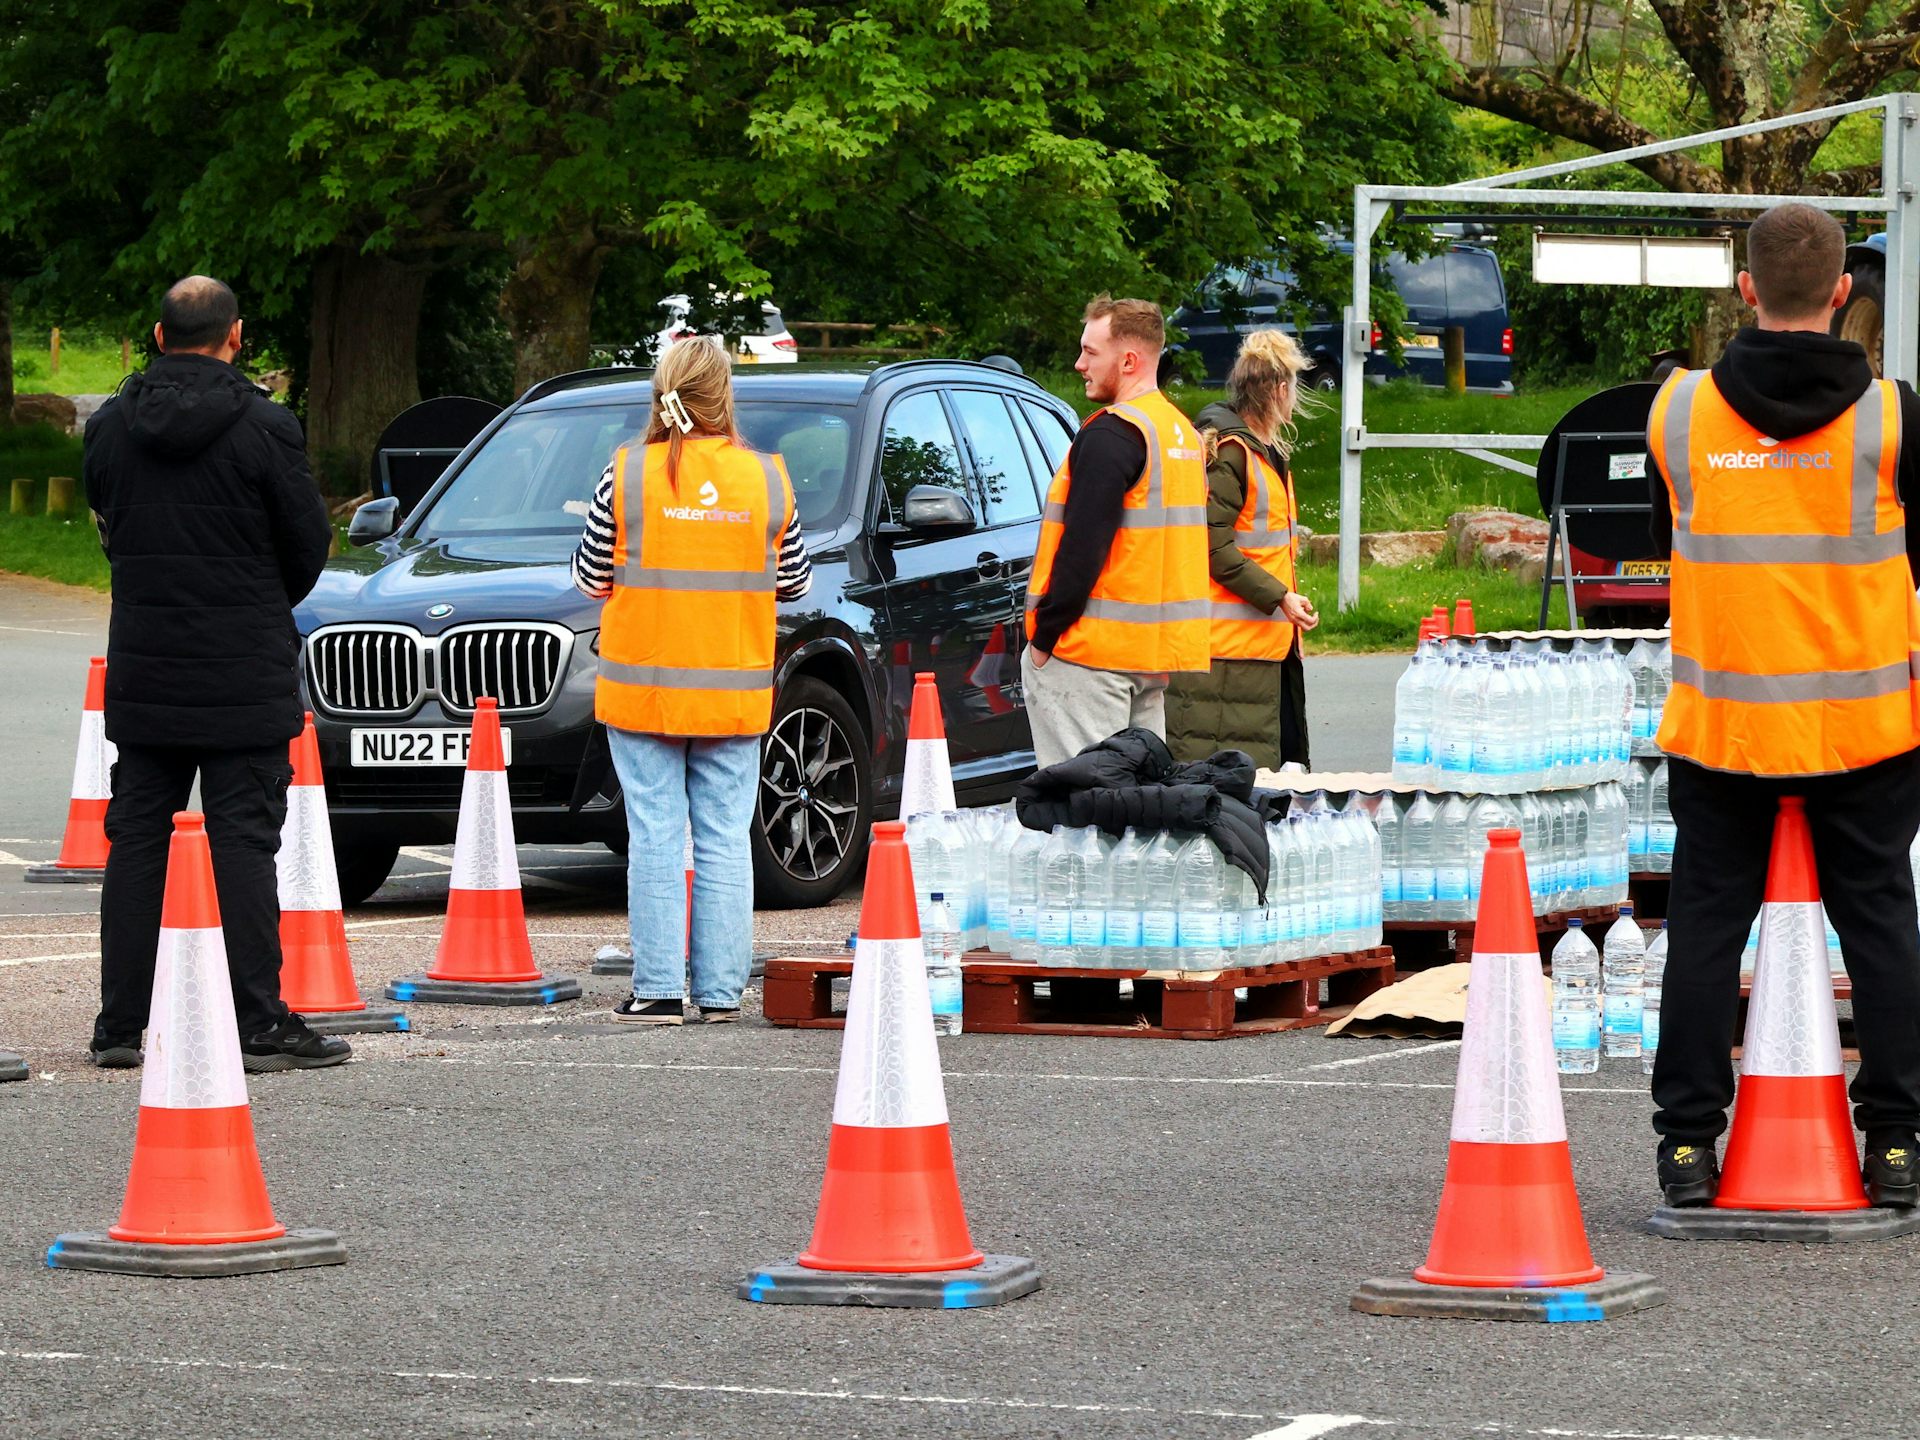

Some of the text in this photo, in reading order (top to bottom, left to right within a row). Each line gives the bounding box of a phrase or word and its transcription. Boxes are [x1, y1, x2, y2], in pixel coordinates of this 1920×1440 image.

[1706, 449, 1833, 469] waterdirect
[662, 506, 751, 523] waterdirect
[362, 733, 434, 761] NU22
